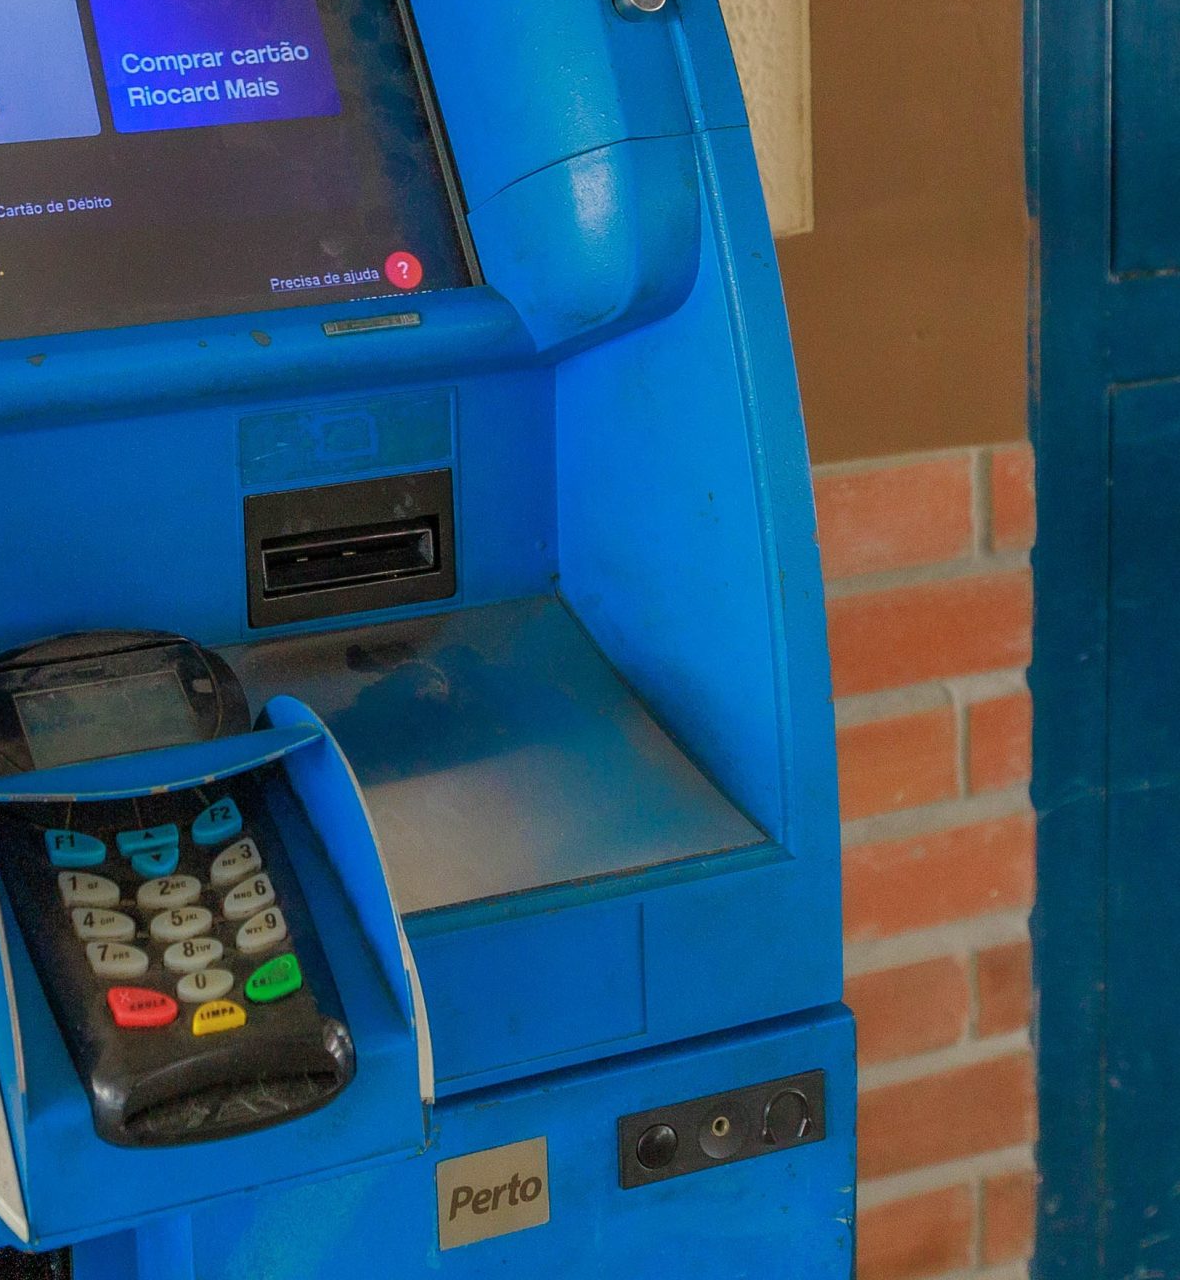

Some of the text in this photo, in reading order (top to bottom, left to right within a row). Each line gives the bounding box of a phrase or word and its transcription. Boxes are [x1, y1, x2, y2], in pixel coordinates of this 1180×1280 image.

[121, 41, 310, 76] Comprar cartão
[127, 77, 280, 108] Riocard Mais
[46, 200, 65, 215] de
[66, 194, 112, 212] Débito
[270, 274, 321, 290] Precisa
[323, 272, 341, 286] de
[343, 267, 380, 285] ajuda
[209, 806, 231, 822] F2
[54, 833, 76, 850] F1
[240, 843, 252, 859] 3
[69, 876, 78, 892] 1
[158, 880, 171, 896] 2
[254, 880, 267, 896] 6
[82, 912, 95, 928] 4
[170, 911, 184, 927] 5
[264, 913, 277, 929] 9
[96, 945, 109, 962] 7
[182, 941, 195, 958] 8
[194, 973, 207, 990] 0
[200, 1005, 235, 1020] LIMPA
[448, 1172, 543, 1222] Perto
